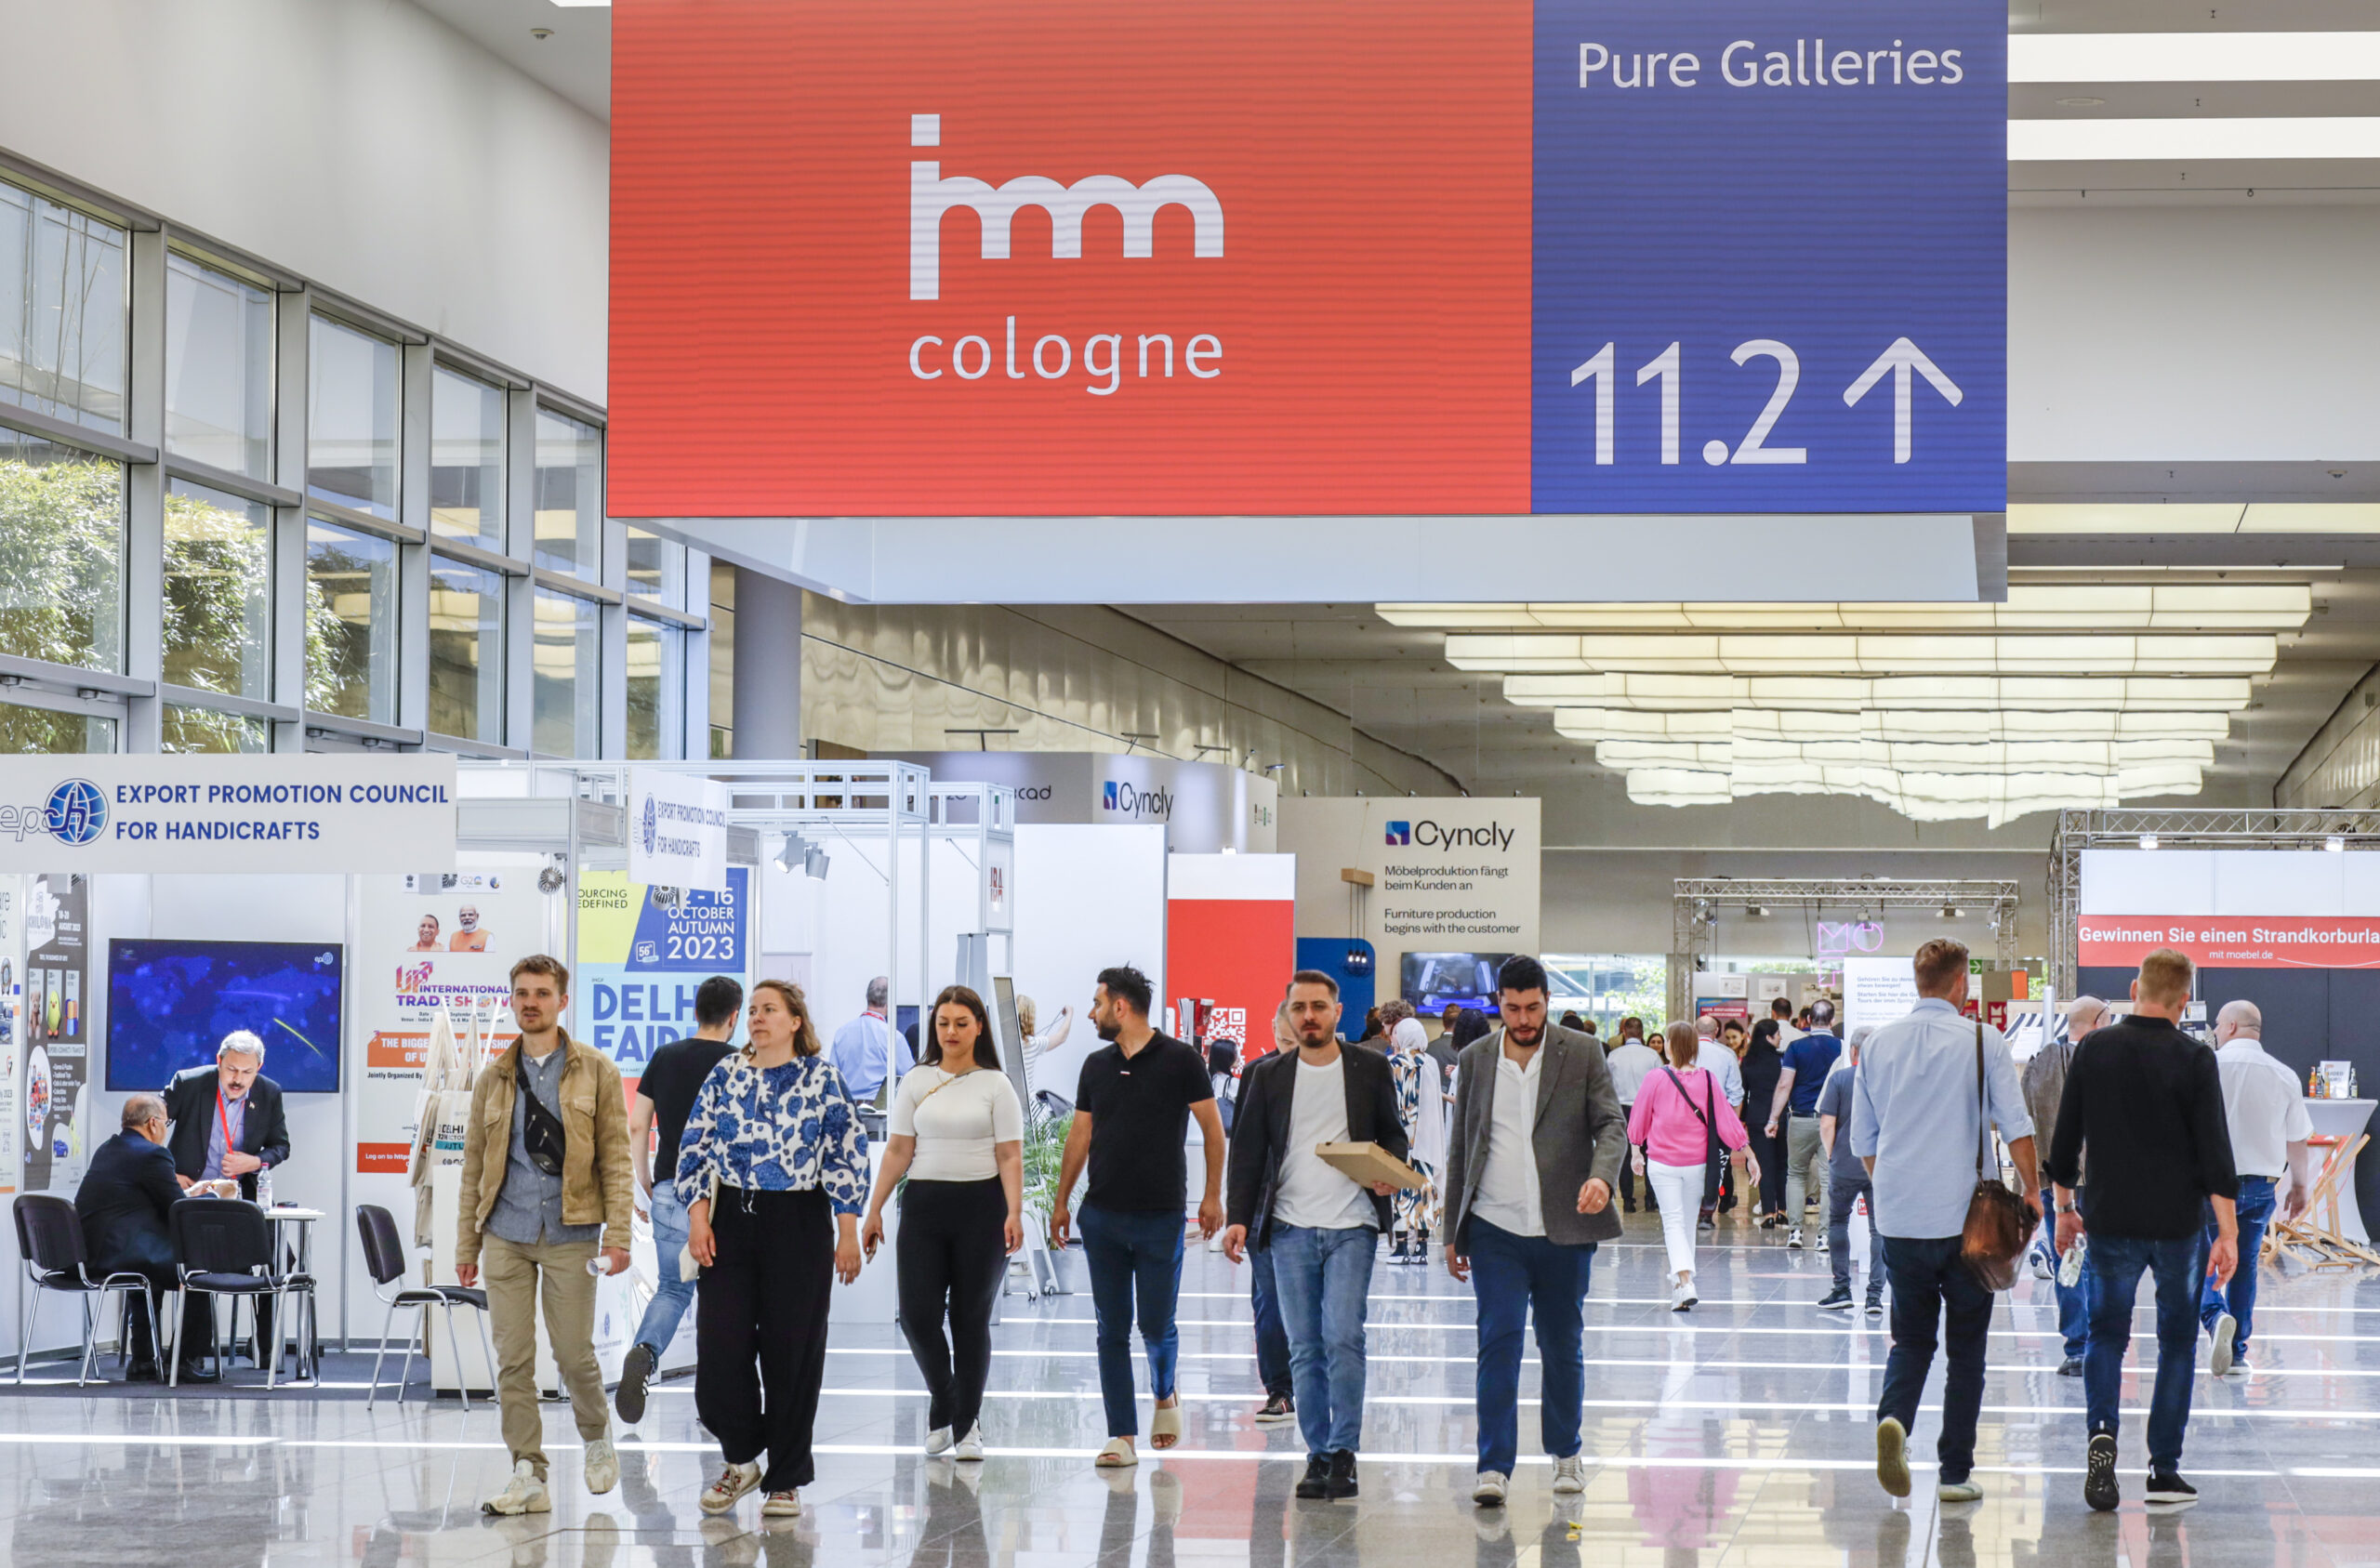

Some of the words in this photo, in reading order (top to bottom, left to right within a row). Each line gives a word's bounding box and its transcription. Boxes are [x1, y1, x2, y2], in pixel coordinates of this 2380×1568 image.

[1577, 41, 1701, 89] Pure
[1720, 37, 1965, 88] Galleries
[909, 112, 1225, 302] imm
[907, 314, 1224, 397] cologne
[1569, 336, 1809, 468] 11.2
[116, 784, 201, 804] EXPORT
[207, 784, 342, 804] PROMOTION
[349, 784, 449, 804] COUNCIL
[1119, 782, 1174, 822] Cyncly
[657, 800, 677, 821] EXPORT
[677, 803, 706, 825] PROMOTION
[706, 808, 725, 828] COUNCIL
[115, 821, 158, 840] FOR
[165, 821, 321, 840] HANDICRAFTS
[1414, 820, 1515, 852] Cyncly
[657, 836, 668, 854] FOR
[668, 837, 701, 858] HANDICRAFTS
[1384, 865, 1479, 878] Möbelproduktion
[1480, 865, 1509, 879] fängt
[1384, 880, 1413, 890] beim
[1414, 880, 1457, 890] Kunden
[1459, 882, 1473, 890] an
[577, 889, 628, 899] OURCING
[577, 899, 628, 909] EDEFINED
[668, 906, 734, 919] OCTOBER
[1384, 908, 1435, 919] Furniture
[1435, 908, 1497, 921] production
[668, 920, 734, 934] AUTUMN
[1384, 923, 1421, 936] begins
[1422, 923, 1447, 934] with
[1448, 923, 1465, 934] the
[1466, 924, 1521, 934] customer
[2079, 927, 2164, 943] Gewinnen
[2168, 928, 2196, 943] Sie
[2200, 928, 2248, 943] einen
[2252, 928, 2380, 944] Strandkorburla
[667, 935, 734, 960] 2023
[2208, 950, 2225, 960] mit
[2226, 950, 2274, 961] moebel.de
[418, 985, 510, 994] INTERNATIONAL
[592, 984, 699, 1021] DELH
[381, 1037, 399, 1048] THE
[401, 1038, 430, 1048] BIGGE
[404, 1051, 417, 1062] OF
[367, 1072, 386, 1080] Jointly
